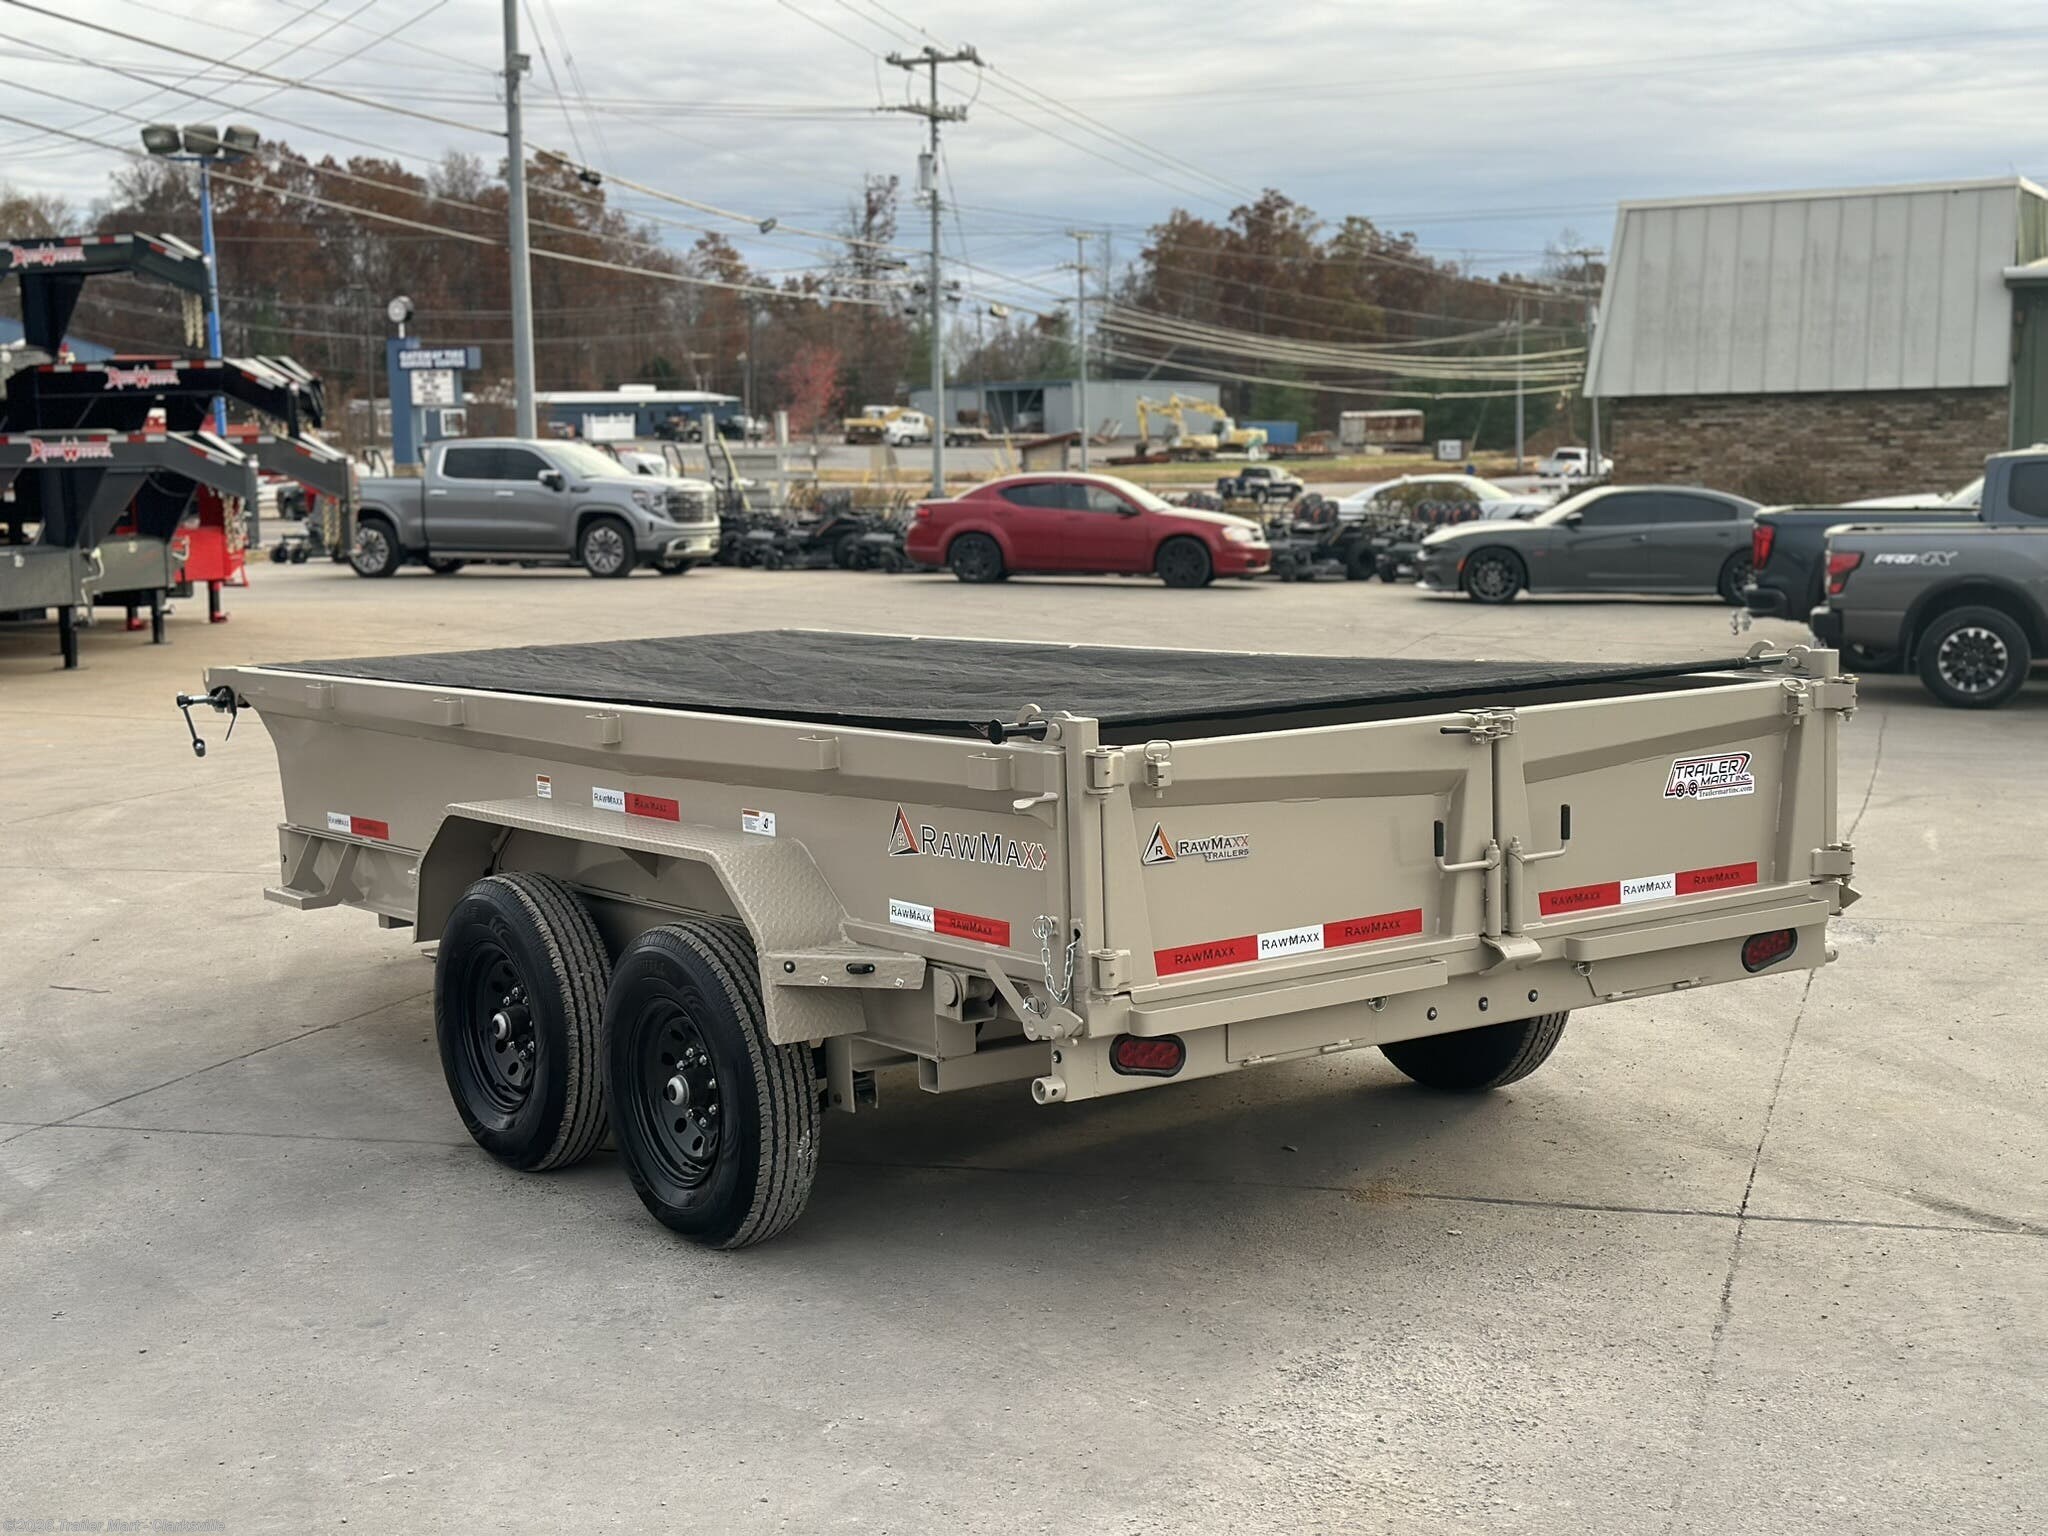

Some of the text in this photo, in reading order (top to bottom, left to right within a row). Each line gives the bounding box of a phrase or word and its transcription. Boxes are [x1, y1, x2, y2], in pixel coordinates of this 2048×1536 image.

[1676, 760, 1739, 779] TRAILER
[1701, 774, 1735, 785] MART
[1155, 845, 1163, 856] R
[1208, 848, 1249, 859] TRAILERS
